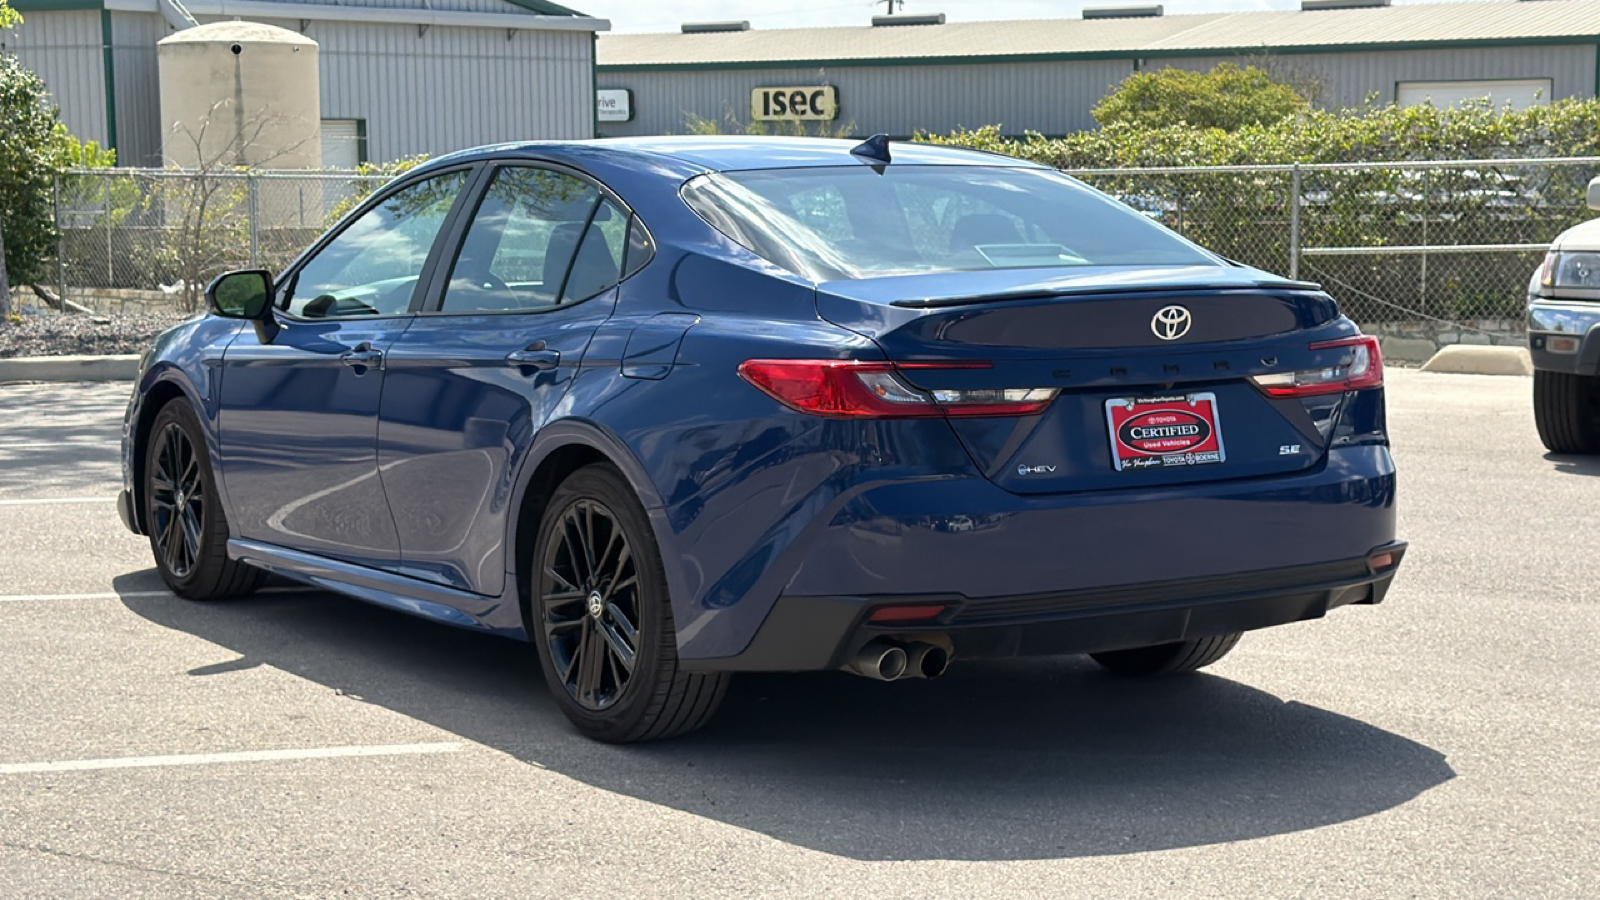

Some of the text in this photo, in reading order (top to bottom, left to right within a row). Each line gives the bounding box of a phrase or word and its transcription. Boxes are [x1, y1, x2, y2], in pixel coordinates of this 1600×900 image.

[598, 96, 616, 108] rive
[1162, 439, 1190, 447] Vehicles
[1279, 445, 1300, 455] SE
[1163, 456, 1185, 464] TOYOTA
